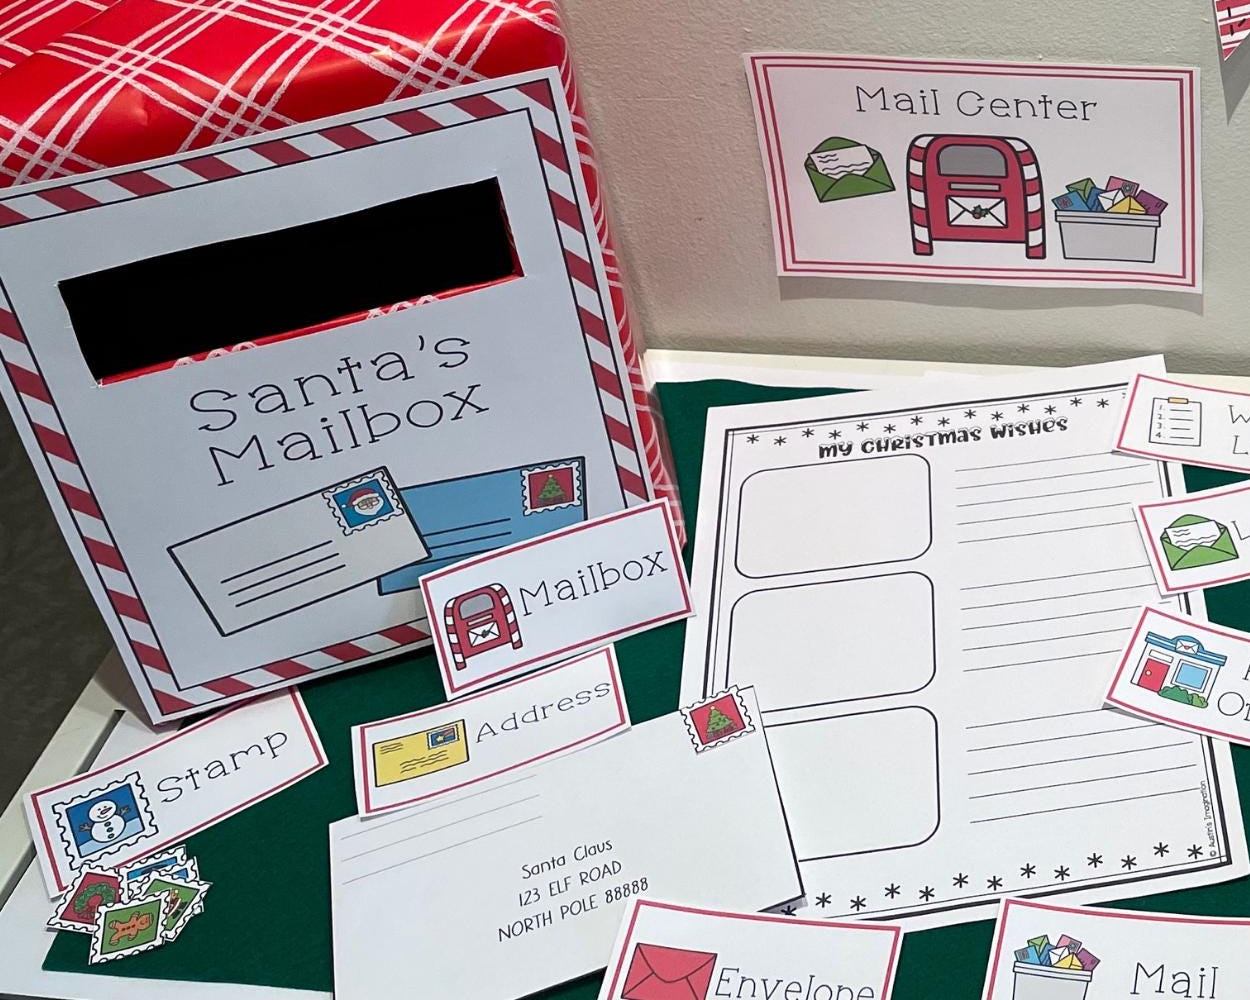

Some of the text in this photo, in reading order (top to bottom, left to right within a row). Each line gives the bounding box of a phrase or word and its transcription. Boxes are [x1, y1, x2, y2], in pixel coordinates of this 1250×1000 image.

[856, 85, 1098, 121] Mail Center
[189, 334, 471, 433] Santa's
[208, 383, 491, 487] Mailbox
[518, 550, 669, 617] Mailbox
[475, 681, 612, 744] Address
[155, 730, 289, 804] Stamp
[519, 859, 623, 906] 123 ELF ROAD
[521, 839, 614, 881] Santa Claus
[499, 876, 650, 942] NORTH POLE 88888
[1130, 962, 1218, 999] Mail
